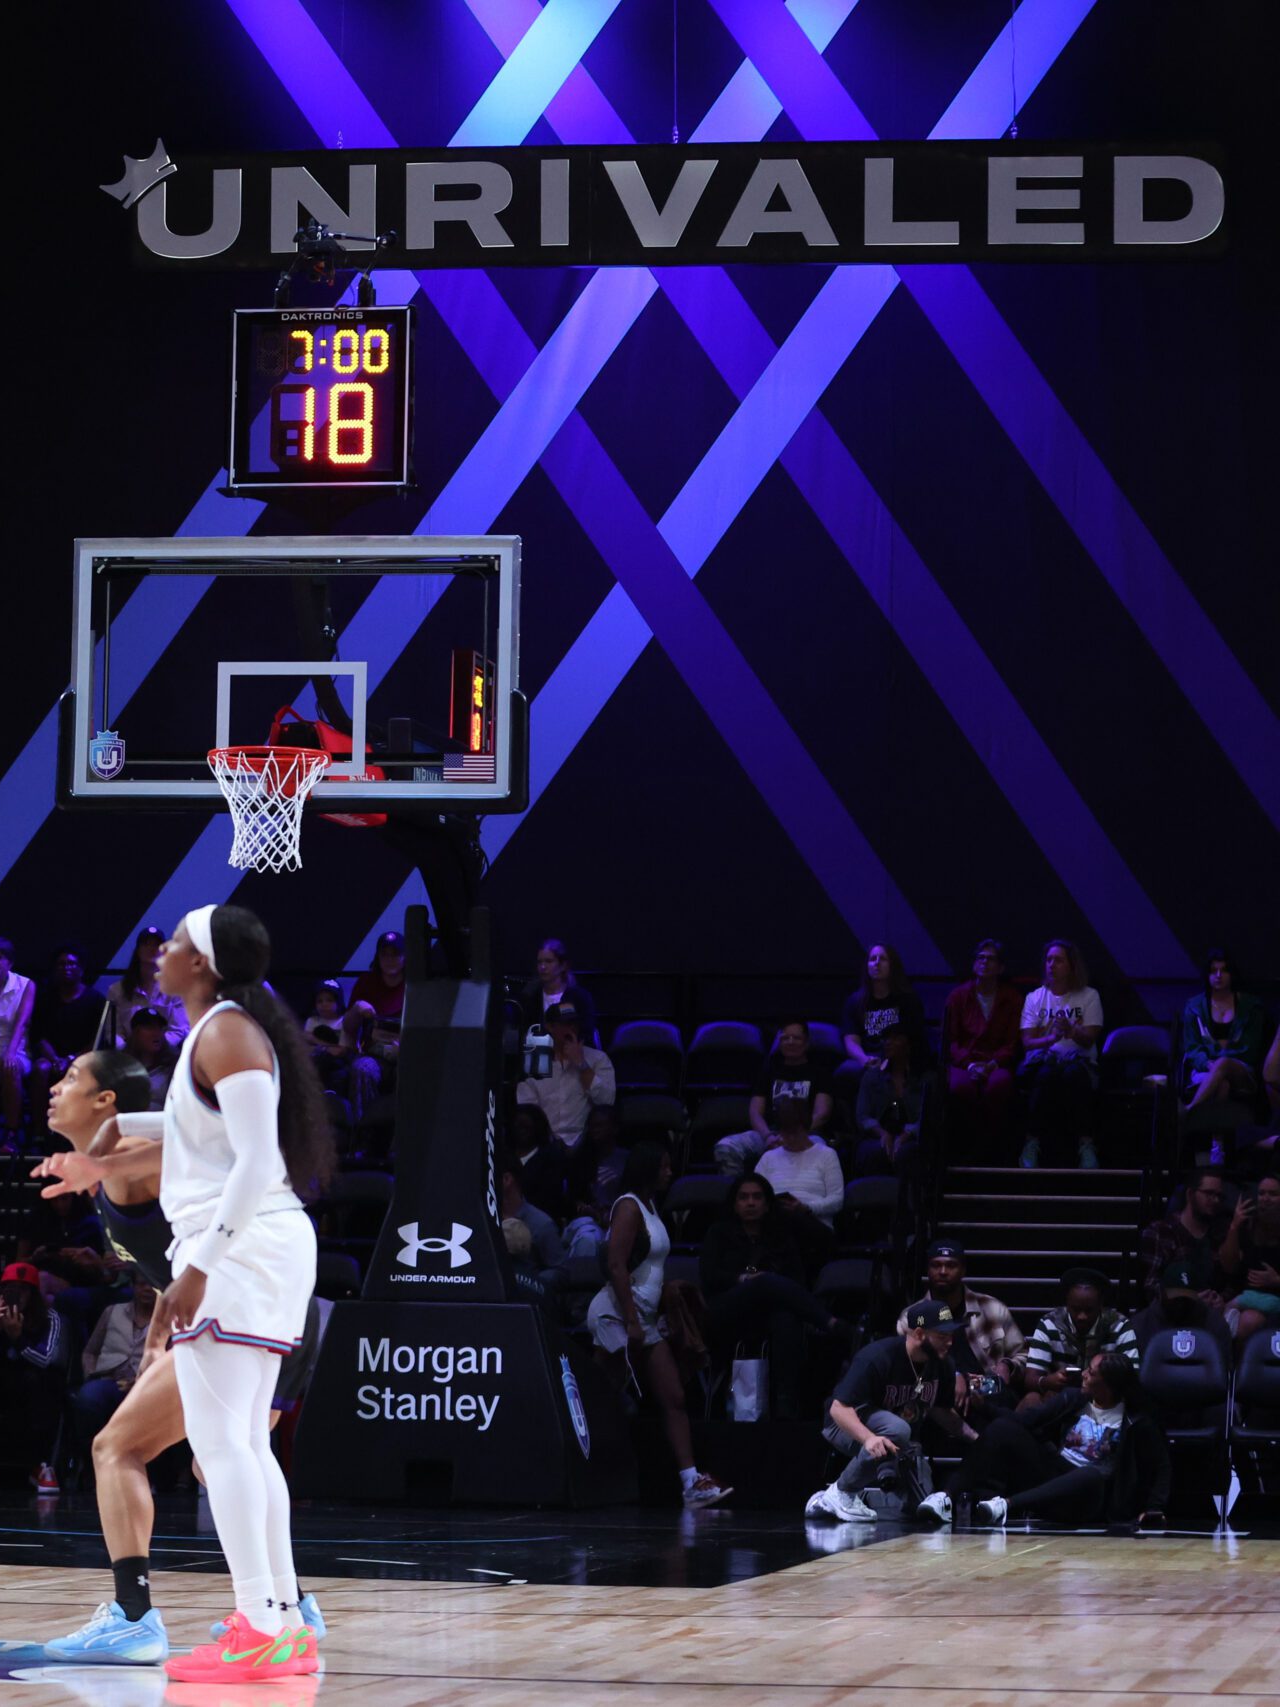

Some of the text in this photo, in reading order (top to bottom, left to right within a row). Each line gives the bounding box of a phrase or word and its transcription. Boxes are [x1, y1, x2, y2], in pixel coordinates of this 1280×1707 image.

[136, 154, 1226, 260] UNRIVALED
[281, 312, 364, 321] DAKTRONICS
[291, 328, 390, 374] 7:00
[303, 382, 374, 464] 18
[485, 1088, 501, 1229] Sprite
[390, 1274, 476, 1284] UNDER ARMOUR
[358, 1337, 503, 1384] Morgan
[356, 1384, 501, 1432] Stanley
